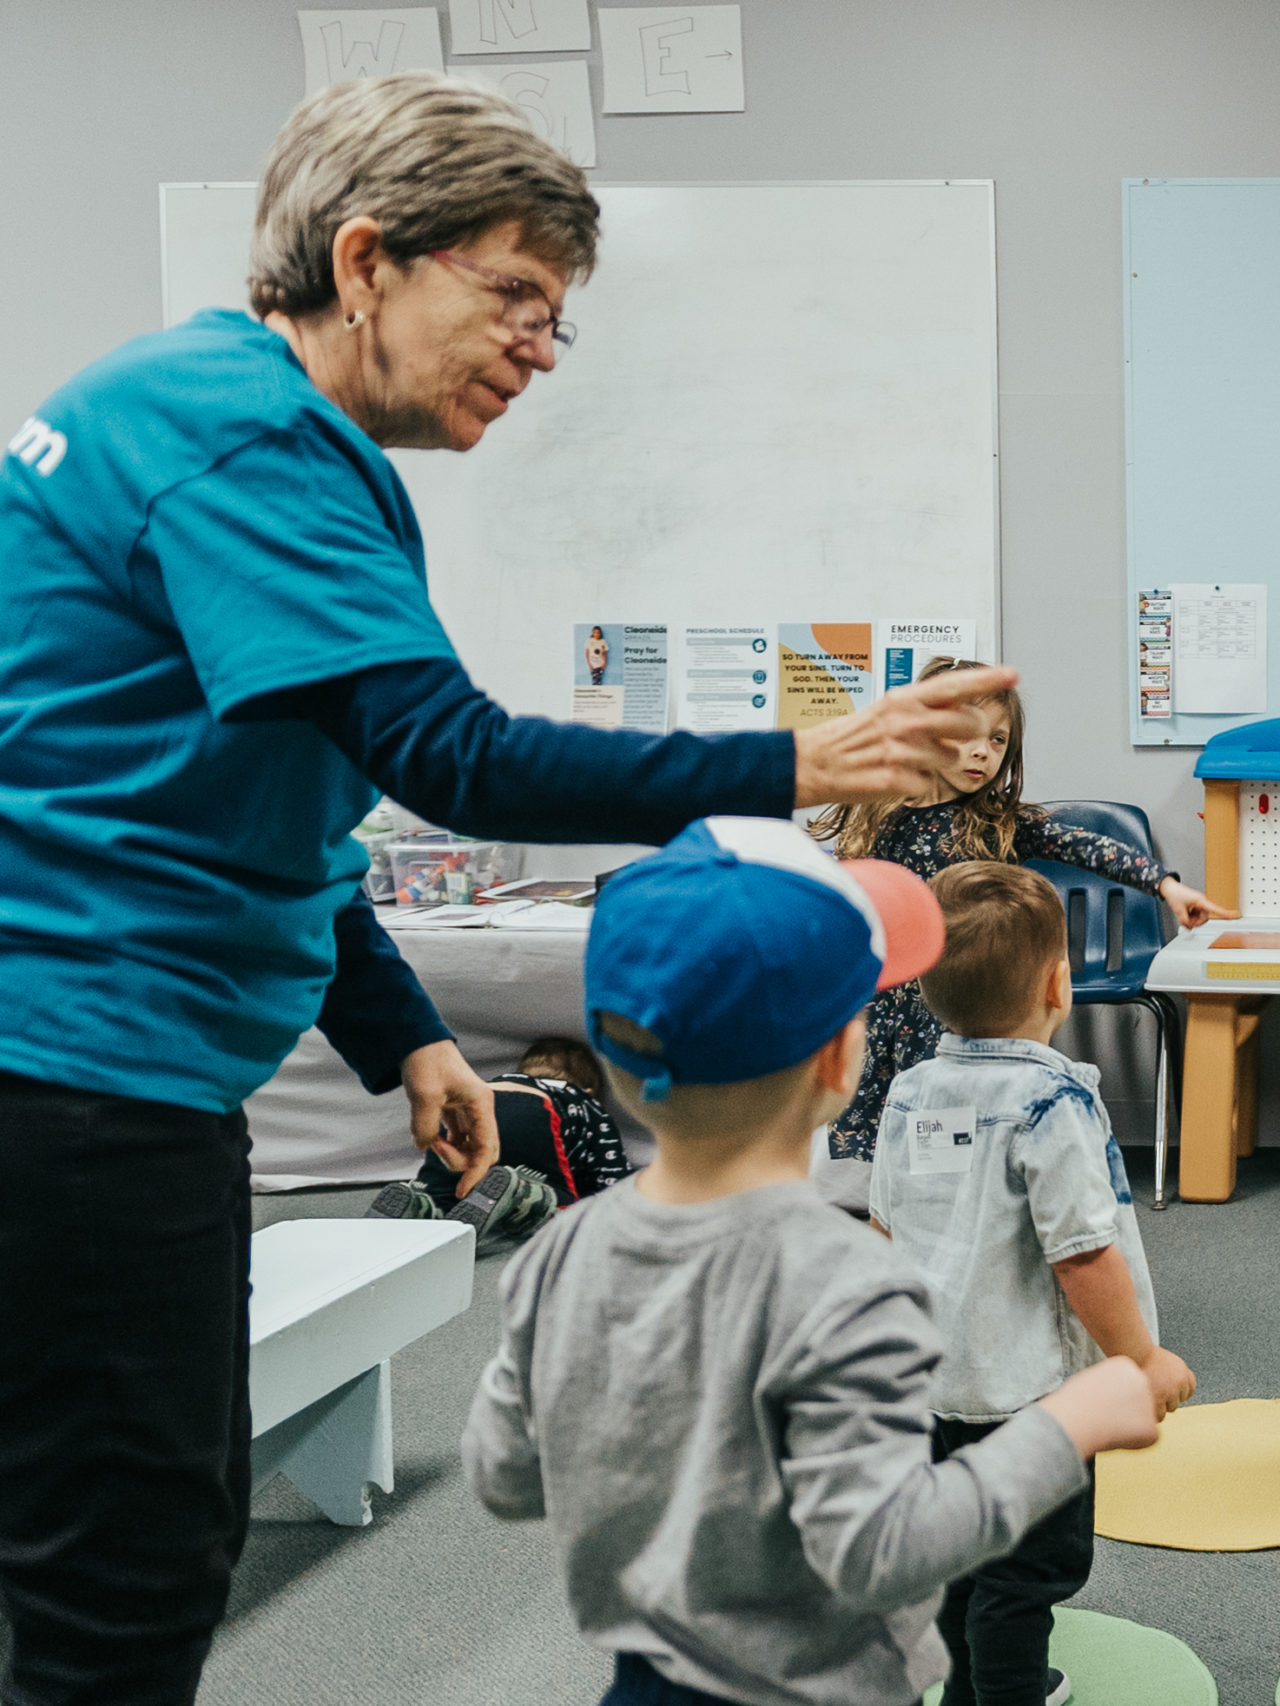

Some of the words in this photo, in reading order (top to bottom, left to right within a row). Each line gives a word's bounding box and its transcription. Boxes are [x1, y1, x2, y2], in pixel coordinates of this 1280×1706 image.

[319, 21, 406, 86] W
[639, 16, 694, 97] E
[891, 624, 960, 634] EMERGENCY
[890, 634, 962, 643] PROCEDURES
[624, 647, 645, 656] Pray
[645, 646, 659, 654] for
[799, 709, 824, 717] ACTS
[916, 1119, 944, 1136] Elijah
